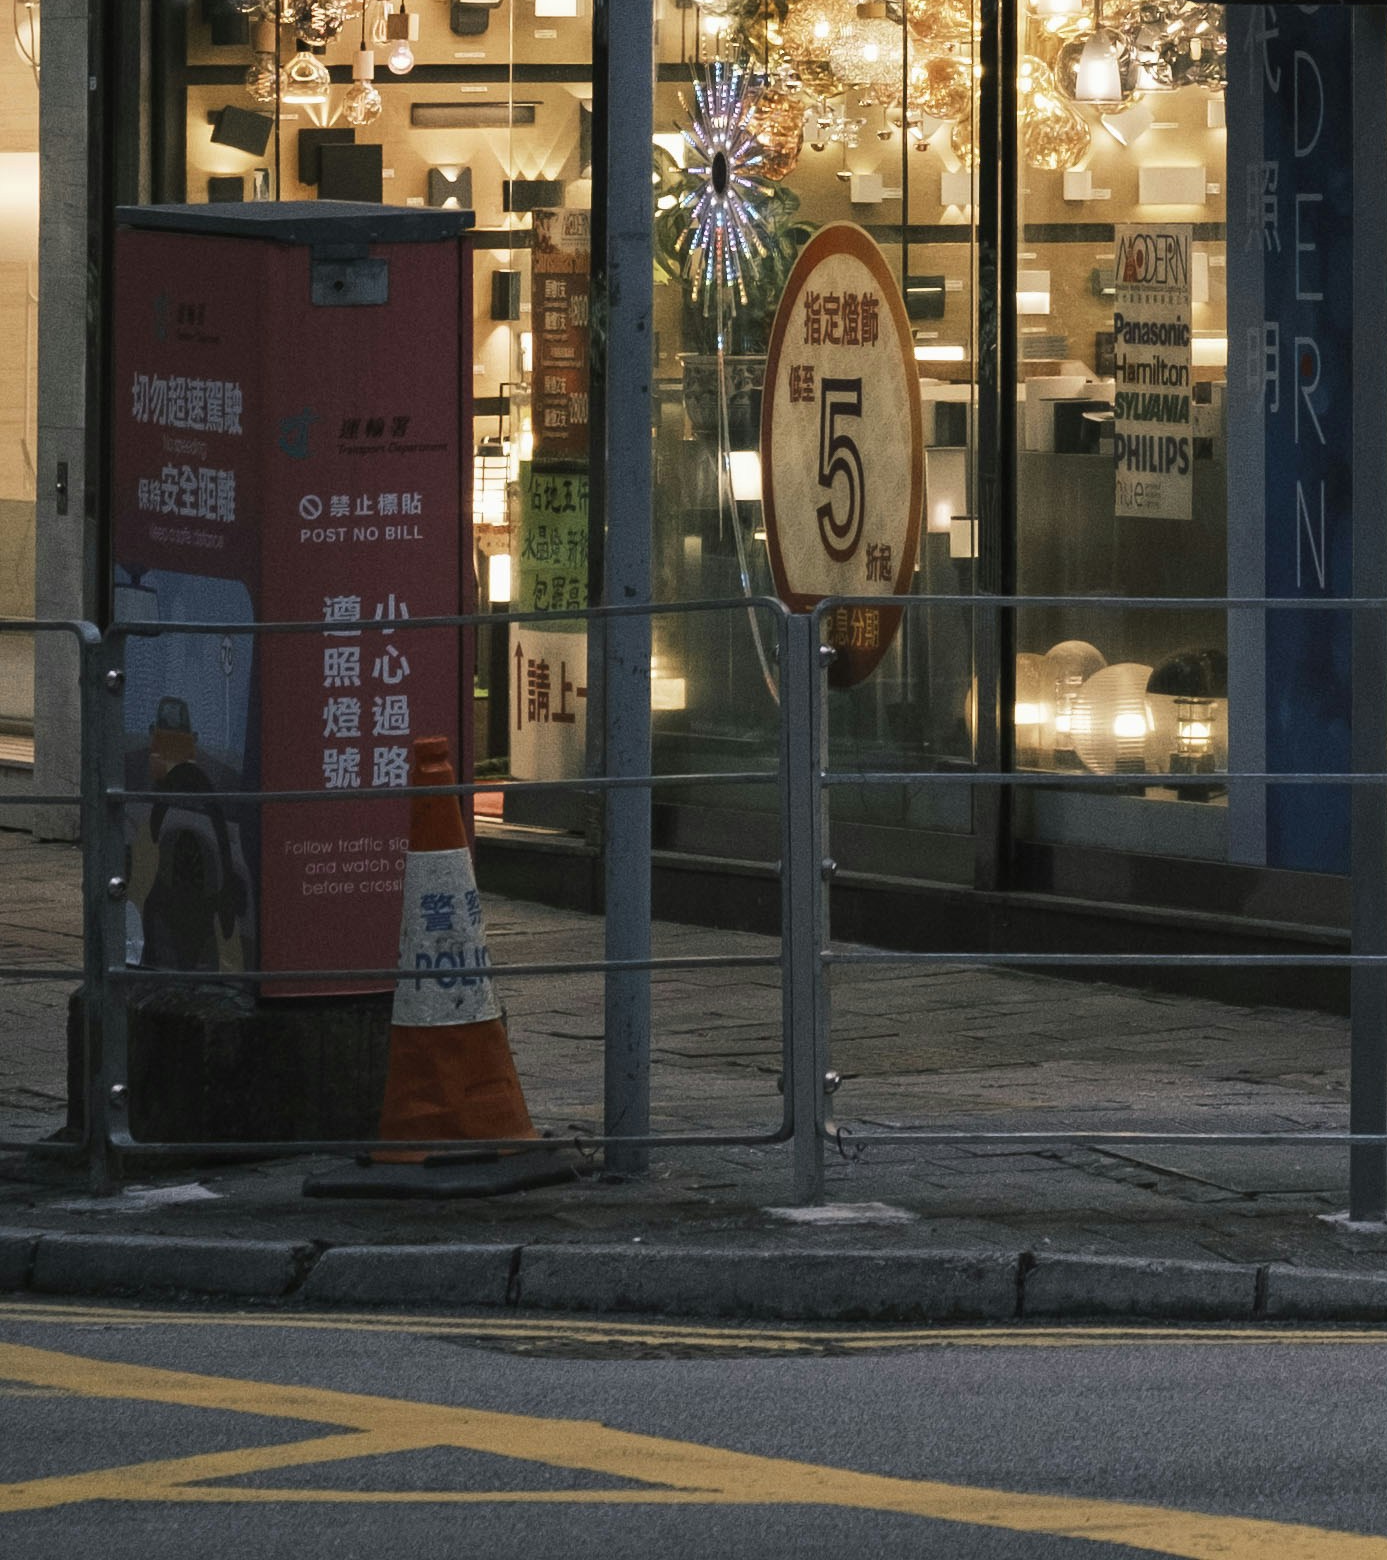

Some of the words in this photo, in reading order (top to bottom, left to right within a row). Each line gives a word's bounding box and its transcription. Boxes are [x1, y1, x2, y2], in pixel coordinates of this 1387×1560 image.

[1244, 4, 1284, 415] 代照明
[804, 291, 880, 347] 指定燈飾
[1114, 312, 1189, 347] Panasonic
[1114, 352, 1189, 387] Hamilton
[1115, 392, 1189, 423] SYLVANIA
[816, 377, 865, 563] 5
[1114, 433, 1189, 475] PHILIPS
[330, 491, 422, 517] 禁止標貼
[300, 528, 347, 542] POST
[353, 526, 379, 541] NO
[385, 524, 423, 540] BILL
[322, 595, 361, 788] 遵照燈號
[371, 593, 410, 788] 小心過路
[285, 840, 333, 856] Follow
[338, 836, 383, 853] traffic
[305, 859, 336, 875] and
[342, 857, 390, 873] watch
[302, 879, 355, 896] before
